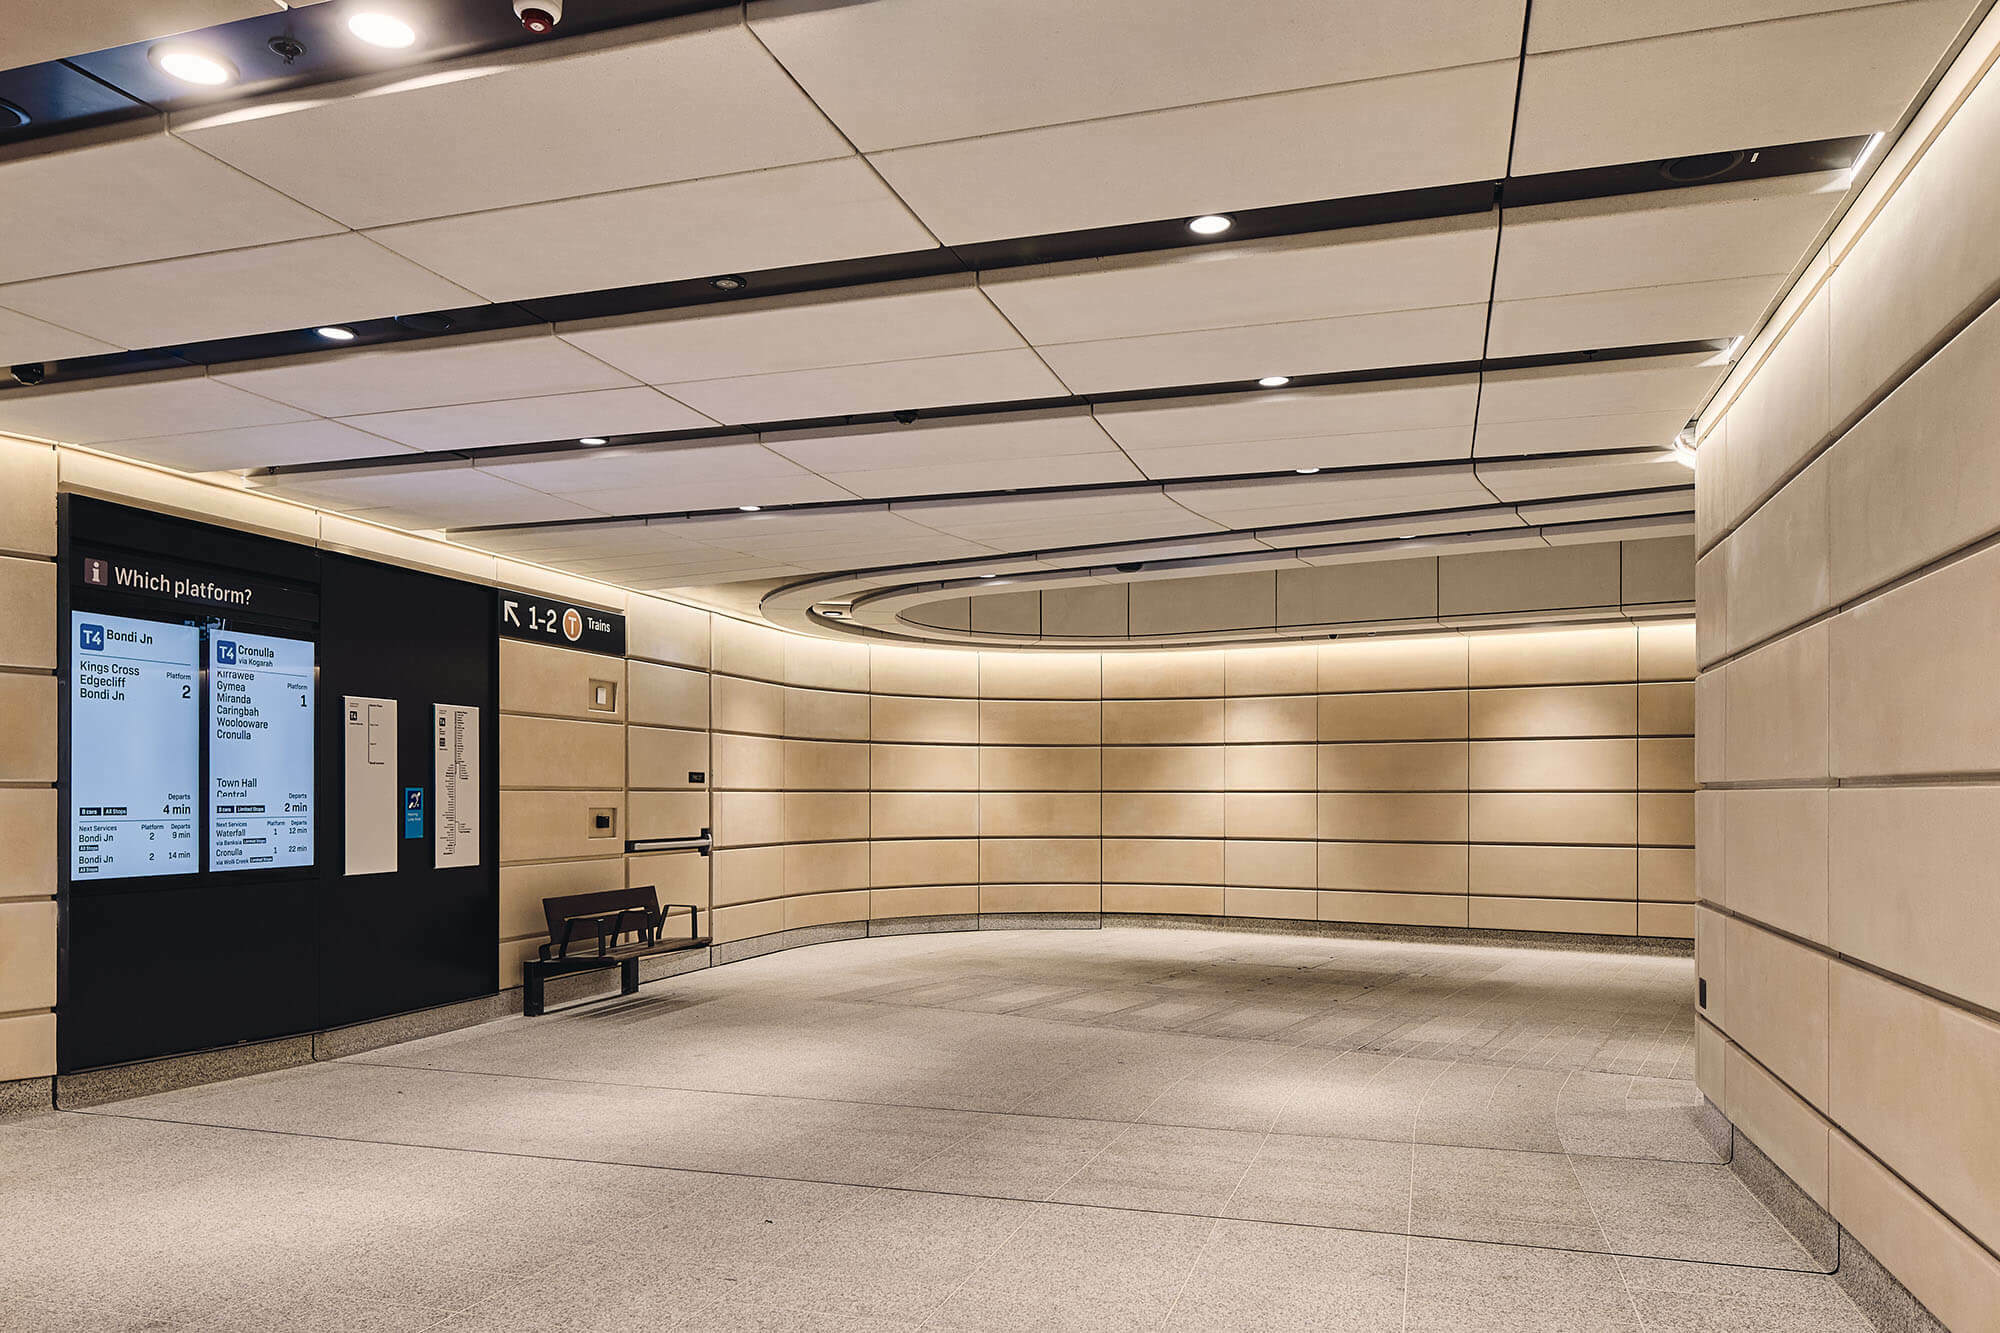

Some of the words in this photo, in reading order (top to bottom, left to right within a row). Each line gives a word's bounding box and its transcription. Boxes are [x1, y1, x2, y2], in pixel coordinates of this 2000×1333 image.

[114, 566, 170, 593] Which
[174, 578, 252, 605] platform?
[528, 606, 557, 634] 1-2
[587, 616, 611, 633] Trains
[83, 630, 102, 646] T4
[106, 629, 137, 642] Bondi
[140, 633, 153, 644] Jn
[219, 646, 234, 660] T4
[238, 644, 274, 658] Cronulla
[80, 660, 109, 674] Kings
[112, 664, 140, 676] Cross
[249, 658, 273, 667] Kogarah
[80, 674, 126, 688] Edgecliff
[166, 672, 192, 680] Platform
[217, 671, 254, 681] Kirrawee
[182, 685, 191, 699] 2
[217, 681, 246, 692] Gymea
[80, 688, 109, 700] Bondi
[112, 690, 125, 701] Jn
[217, 693, 251, 704] Miranda
[301, 695, 307, 707] 1
[217, 705, 259, 718] Caringbah
[217, 717, 268, 729] Woolooware
[217, 729, 251, 740] Cronulla
[216, 778, 239, 787] Town
[242, 778, 257, 787] Hall
[163, 805, 170, 814] 4
[172, 804, 191, 814] min
[284, 803, 290, 812] 2
[292, 802, 307, 812] min
[79, 834, 102, 842] Bondi
[216, 848, 242, 856] Cronulla
[79, 855, 102, 864] Bondi
